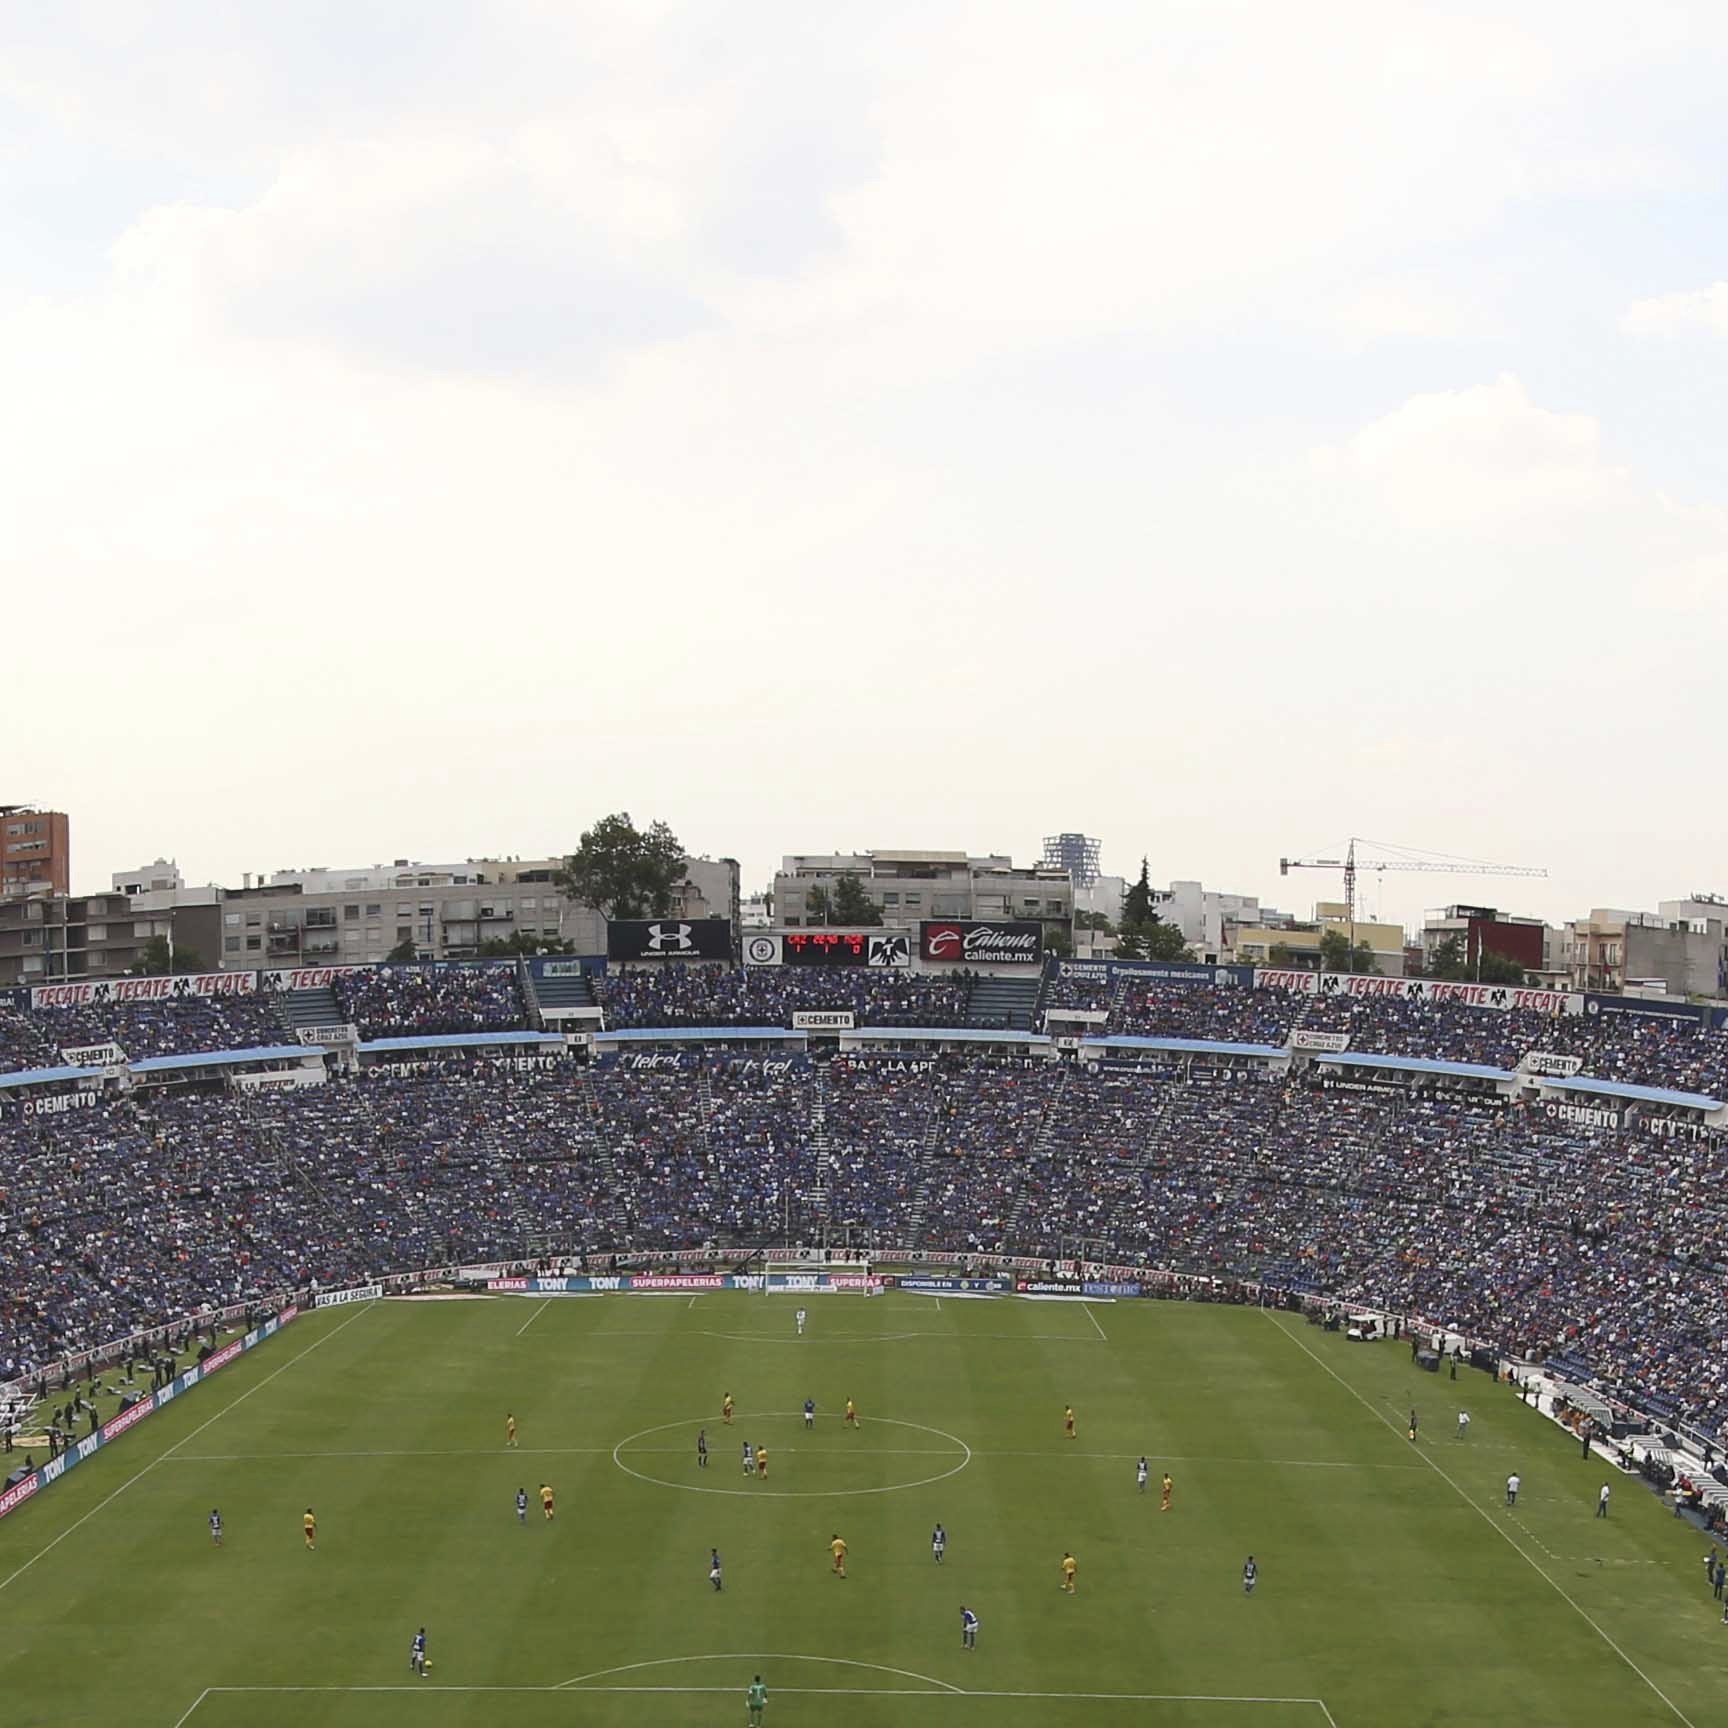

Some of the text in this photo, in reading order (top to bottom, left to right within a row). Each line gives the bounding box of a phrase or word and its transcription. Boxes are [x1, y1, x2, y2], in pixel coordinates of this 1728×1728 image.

[963, 926, 1037, 949] Caliente
[964, 949, 1033, 962] caliente.mx
[115, 979, 170, 999] TECATE
[196, 973, 254, 994] TECATE
[1258, 972, 1314, 991] TECATE
[1346, 977, 1406, 998] TECATE
[37, 984, 92, 1006] TECATE
[1431, 983, 1490, 1005] TECATE
[1512, 991, 1569, 1011] TECATE
[808, 1014, 850, 1025] CEMENTO
[75, 1047, 114, 1063] CEMENTO
[1539, 1057, 1577, 1071] CEMENTO
[1336, 1081, 1366, 1092] UNDER
[35, 1092, 97, 1115] CEMENTO
[1558, 1103, 1619, 1130] CEMENTO
[488, 1280, 527, 1290] ELERIAS
[537, 1277, 569, 1291] TONY
[589, 1276, 621, 1290] TONY
[632, 1278, 723, 1288] SUPERPAPELERIAS
[732, 1275, 765, 1290] TONY
[786, 1275, 818, 1288] TONY
[1026, 1281, 1081, 1292] caliente.mx
[317, 1296, 332, 1307] VAS
[339, 1293, 351, 1304] LA
[183, 1366, 200, 1389] TONY
[156, 1382, 175, 1406] TONY
[103, 1401, 154, 1441] SUPERPAPELERIAS
[78, 1432, 99, 1460] TONY
[43, 1454, 66, 1484] TONY
